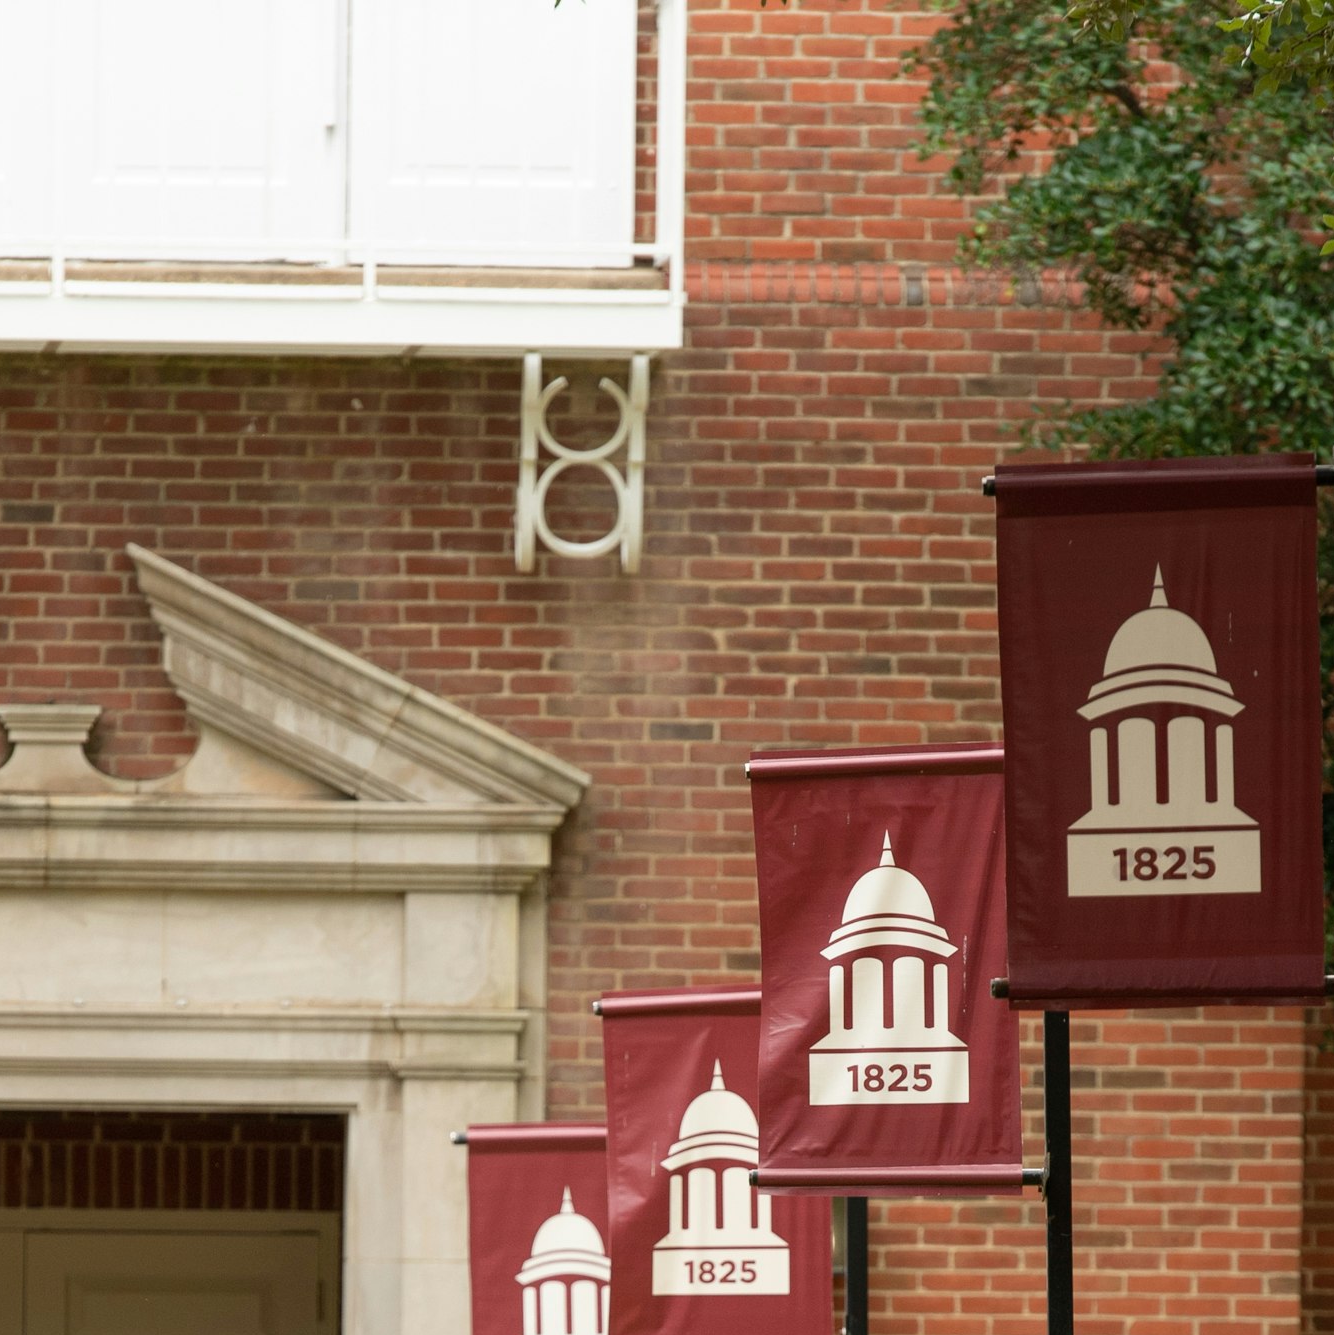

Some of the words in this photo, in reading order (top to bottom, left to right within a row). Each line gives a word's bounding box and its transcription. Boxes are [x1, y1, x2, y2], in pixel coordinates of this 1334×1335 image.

[1112, 845, 1217, 882] 1825
[846, 1063, 934, 1093] 1825
[684, 1259, 758, 1285] 1825
